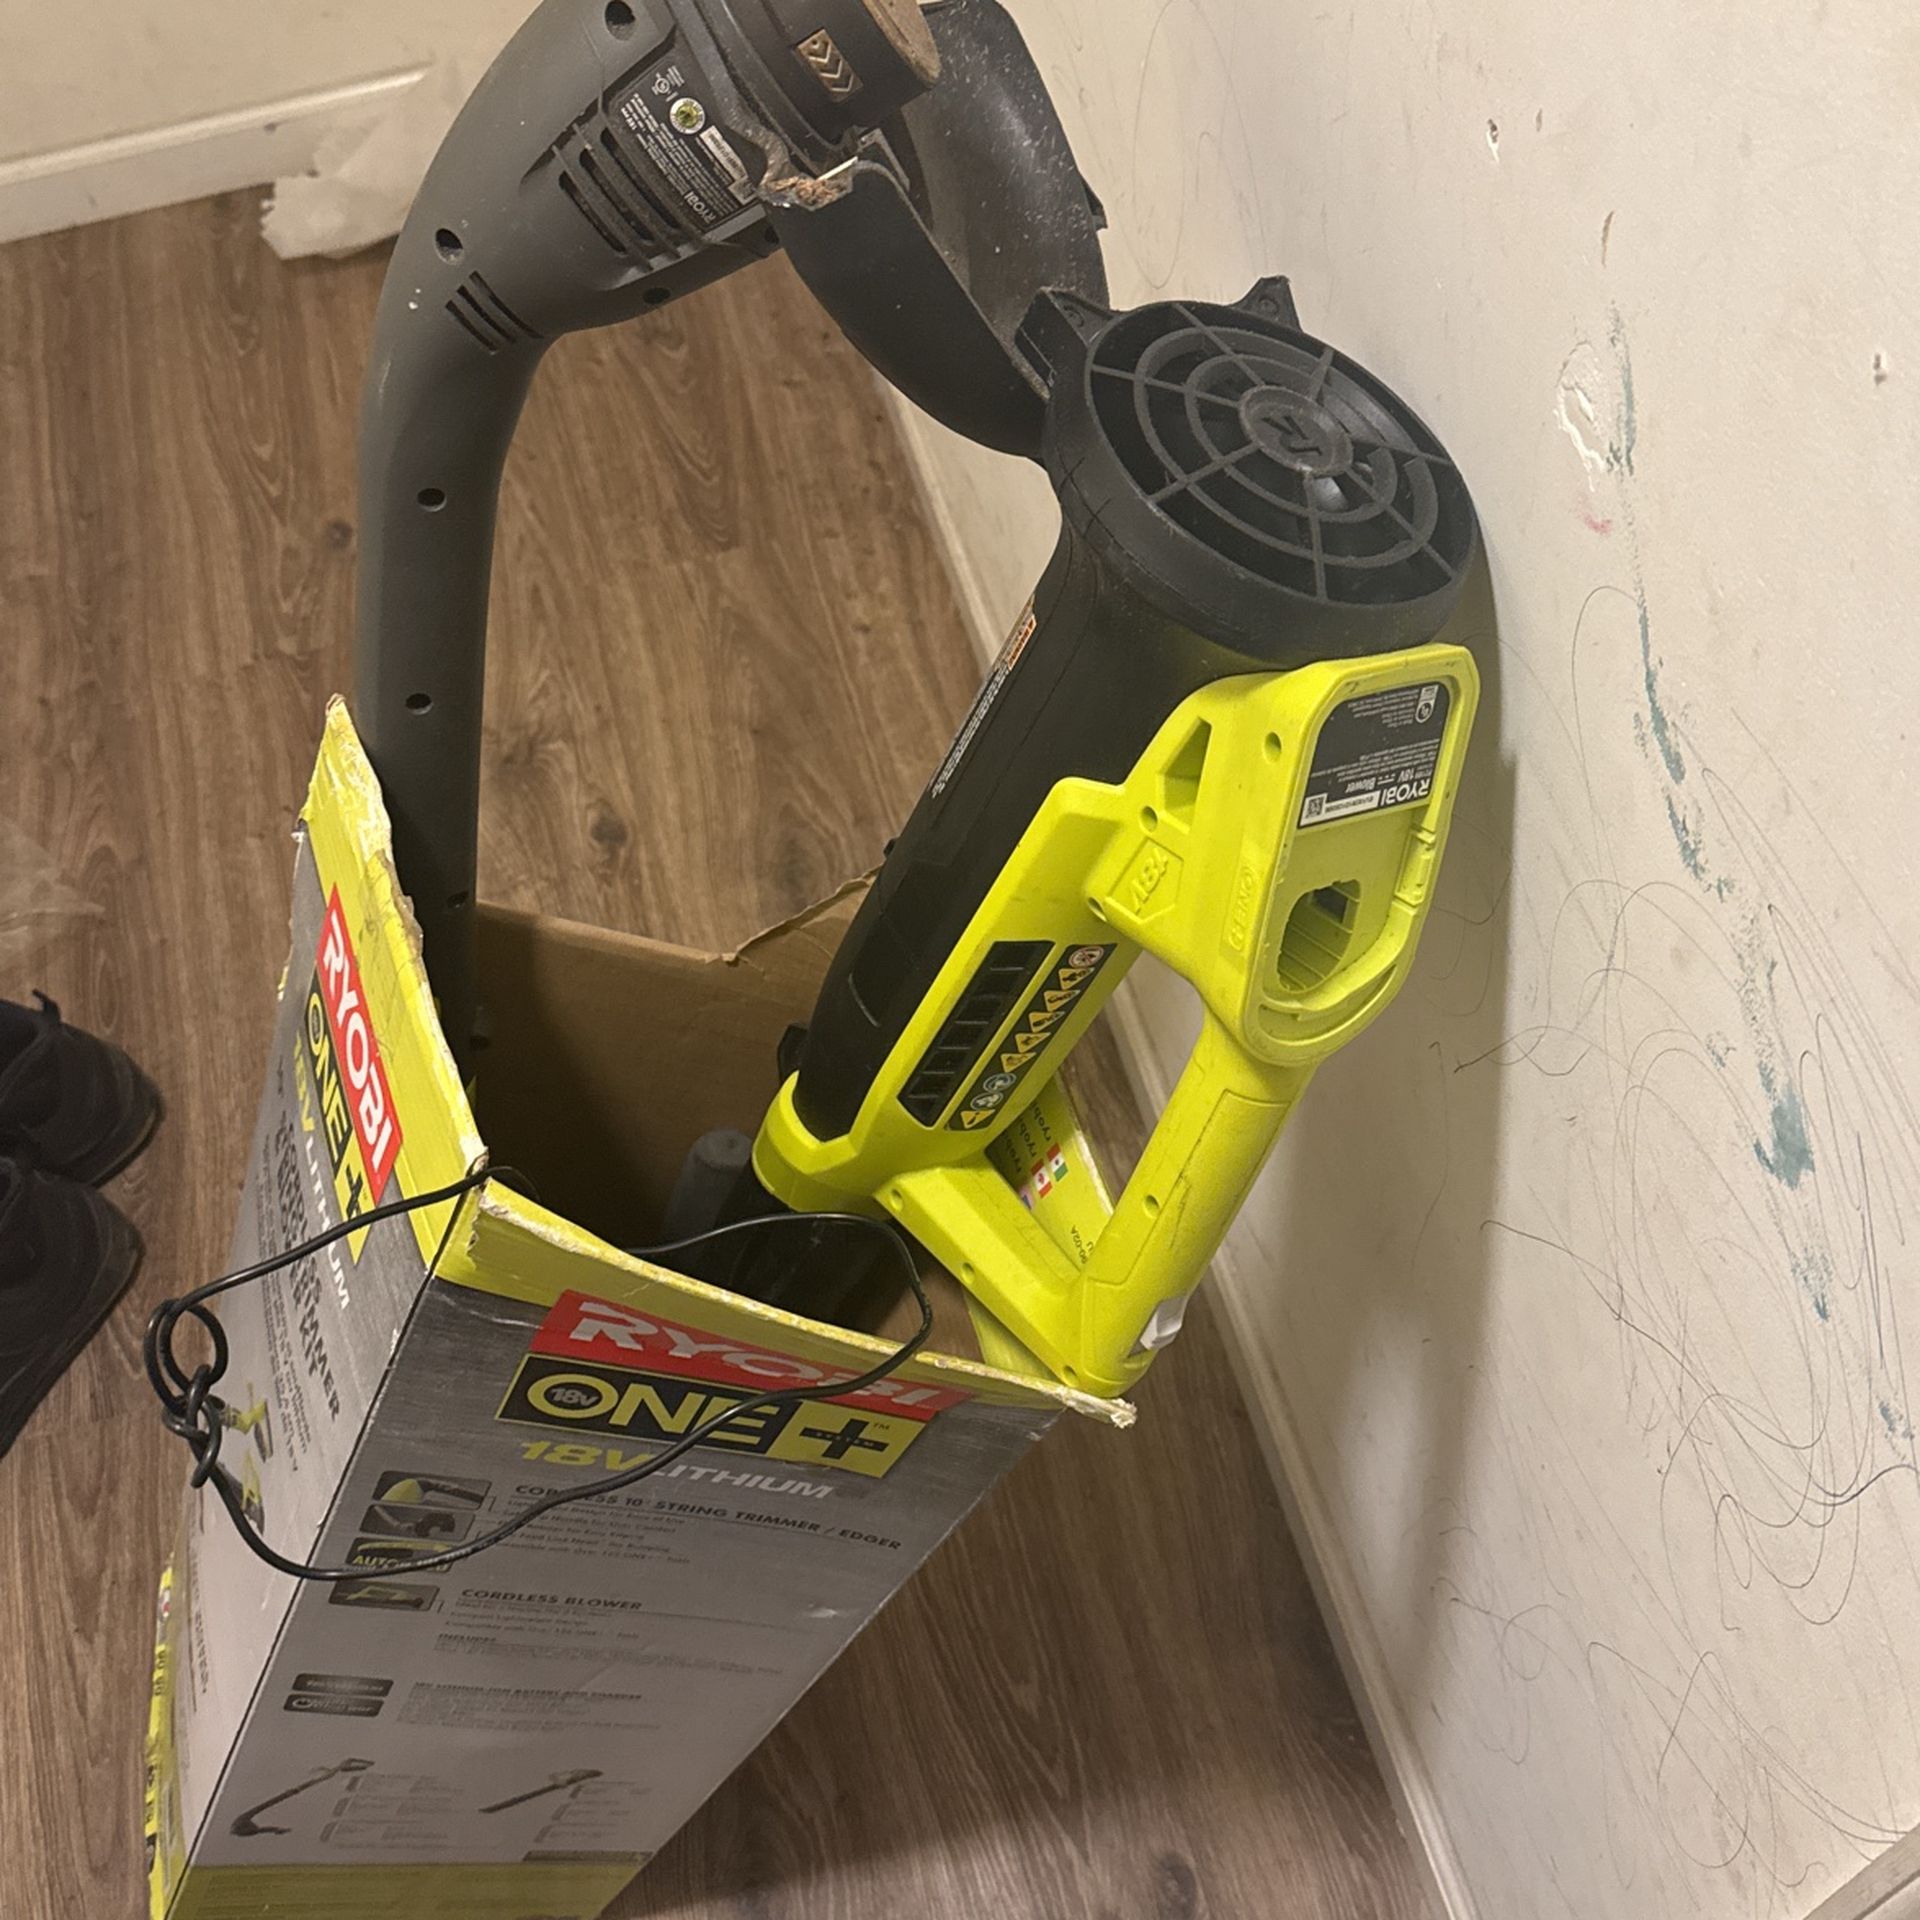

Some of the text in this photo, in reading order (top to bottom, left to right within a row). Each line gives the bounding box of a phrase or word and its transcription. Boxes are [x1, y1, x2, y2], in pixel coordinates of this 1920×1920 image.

[684, 190, 716, 224] RYOBI
[1380, 778, 1430, 806] RYOBI
[324, 908, 392, 1173] RYOBI
[287, 1122, 322, 1301] CORDLSS
[306, 1135, 350, 1310] LITHUM
[570, 1302, 939, 1407] RYOBI
[520, 1439, 656, 1472] 18V
[515, 1484, 618, 1503] CORESS
[656, 1501, 728, 1518] STRING
[735, 1511, 821, 1533] TRIMMER
[839, 1529, 901, 1551] EDGER
[461, 1588, 558, 1604] CORDLESS
[564, 1597, 643, 1611] BLOWER
